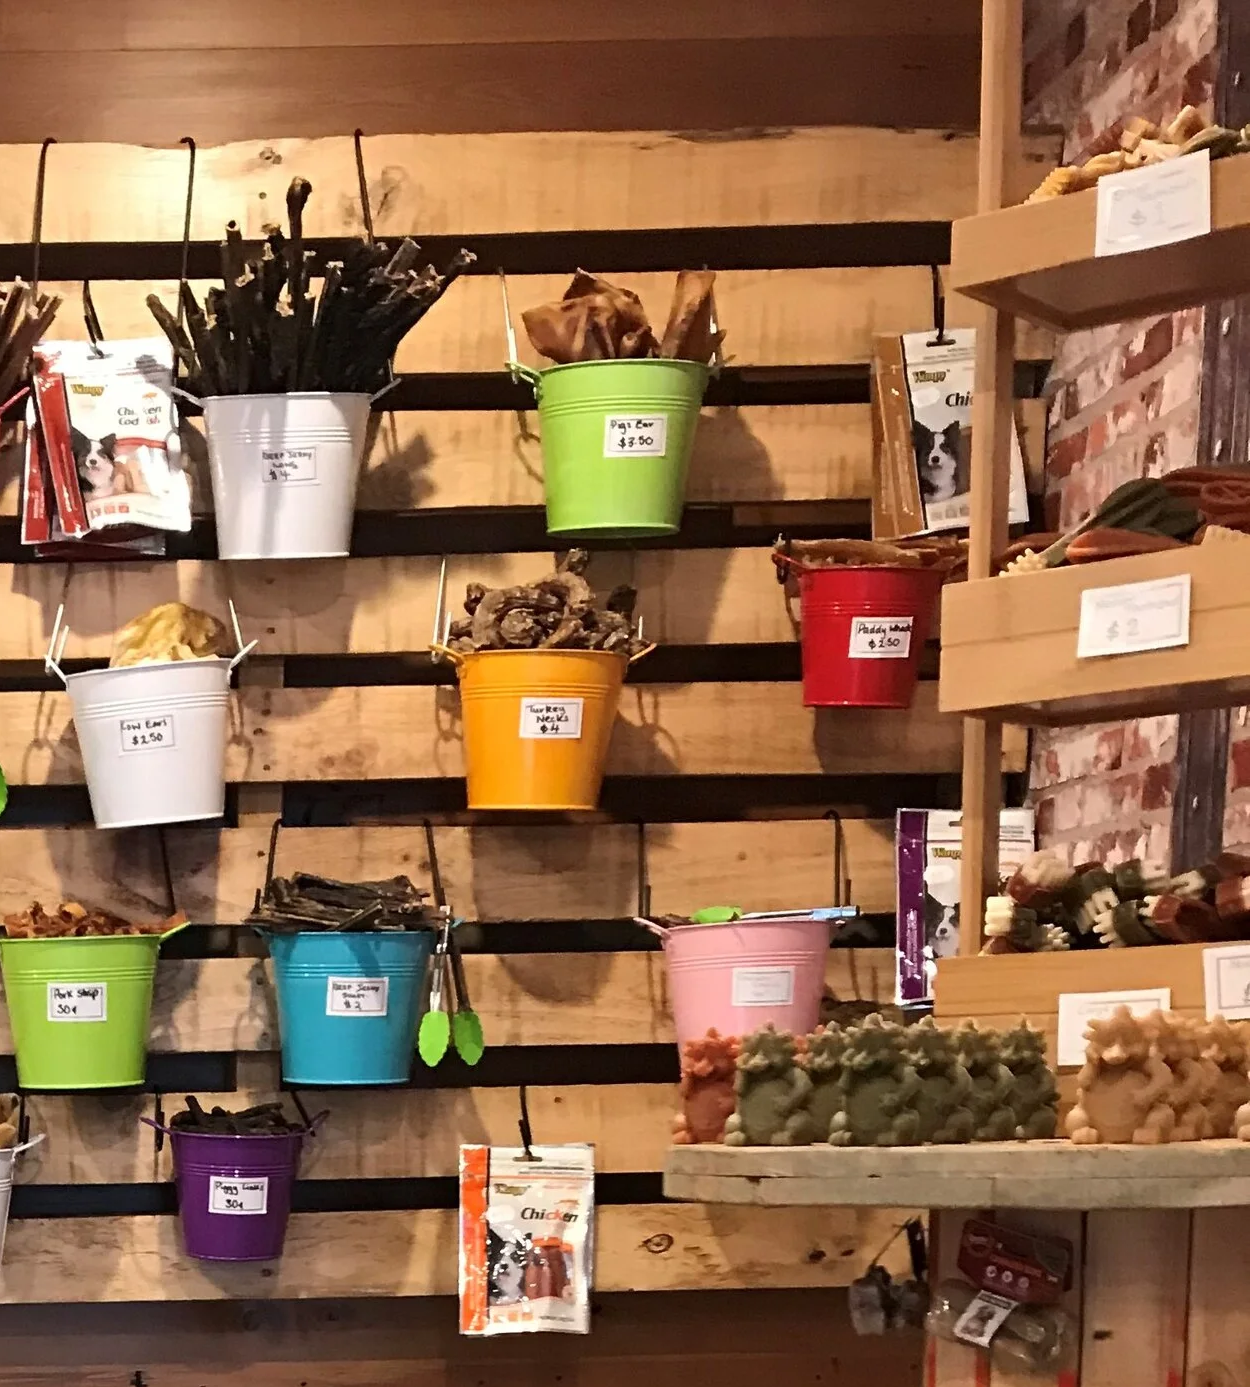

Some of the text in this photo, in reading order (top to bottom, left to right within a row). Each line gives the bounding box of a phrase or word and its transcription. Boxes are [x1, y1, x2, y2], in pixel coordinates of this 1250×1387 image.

[857, 623, 887, 640] Paddy
[525, 704, 566, 717] Turkey
[520, 1207, 579, 1223] Chicken
